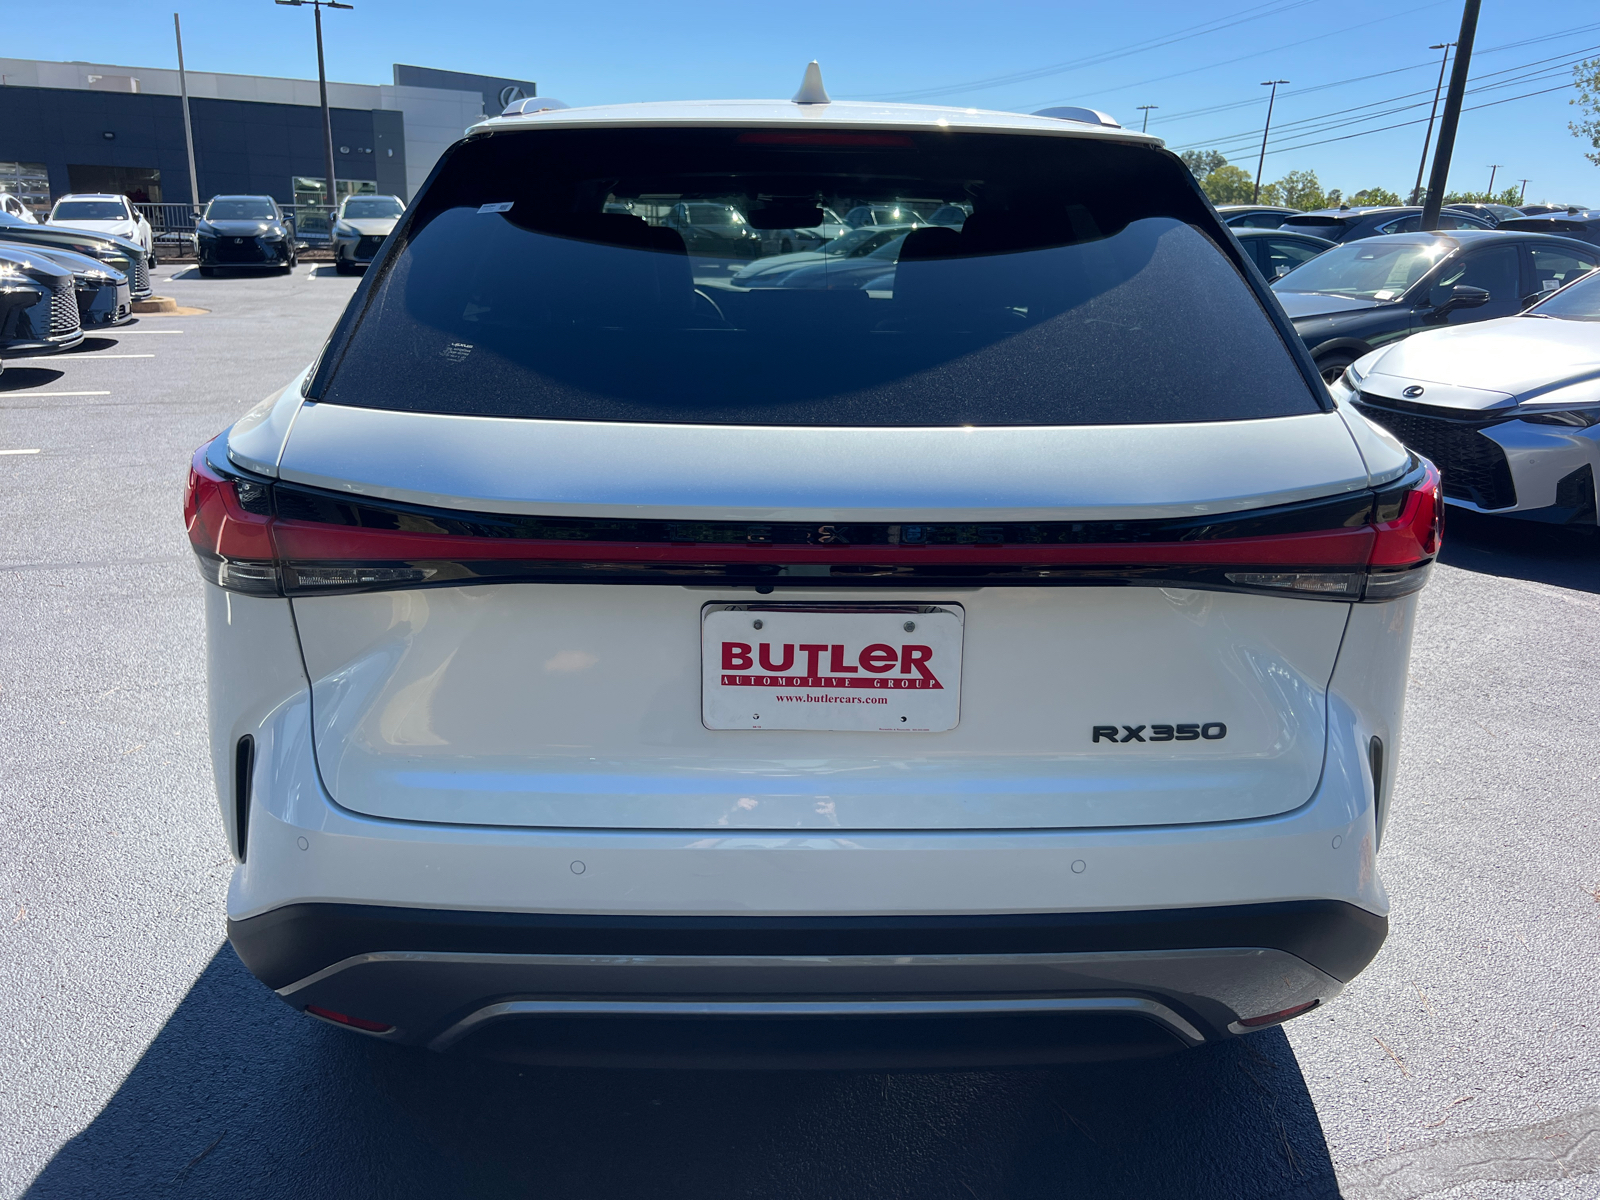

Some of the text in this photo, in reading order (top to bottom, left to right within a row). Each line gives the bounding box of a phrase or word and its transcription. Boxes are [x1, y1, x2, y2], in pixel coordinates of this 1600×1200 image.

[722, 676, 937, 688] AUTOMOTIVE GROUP
[776, 693, 888, 705] www.butlercars.com
